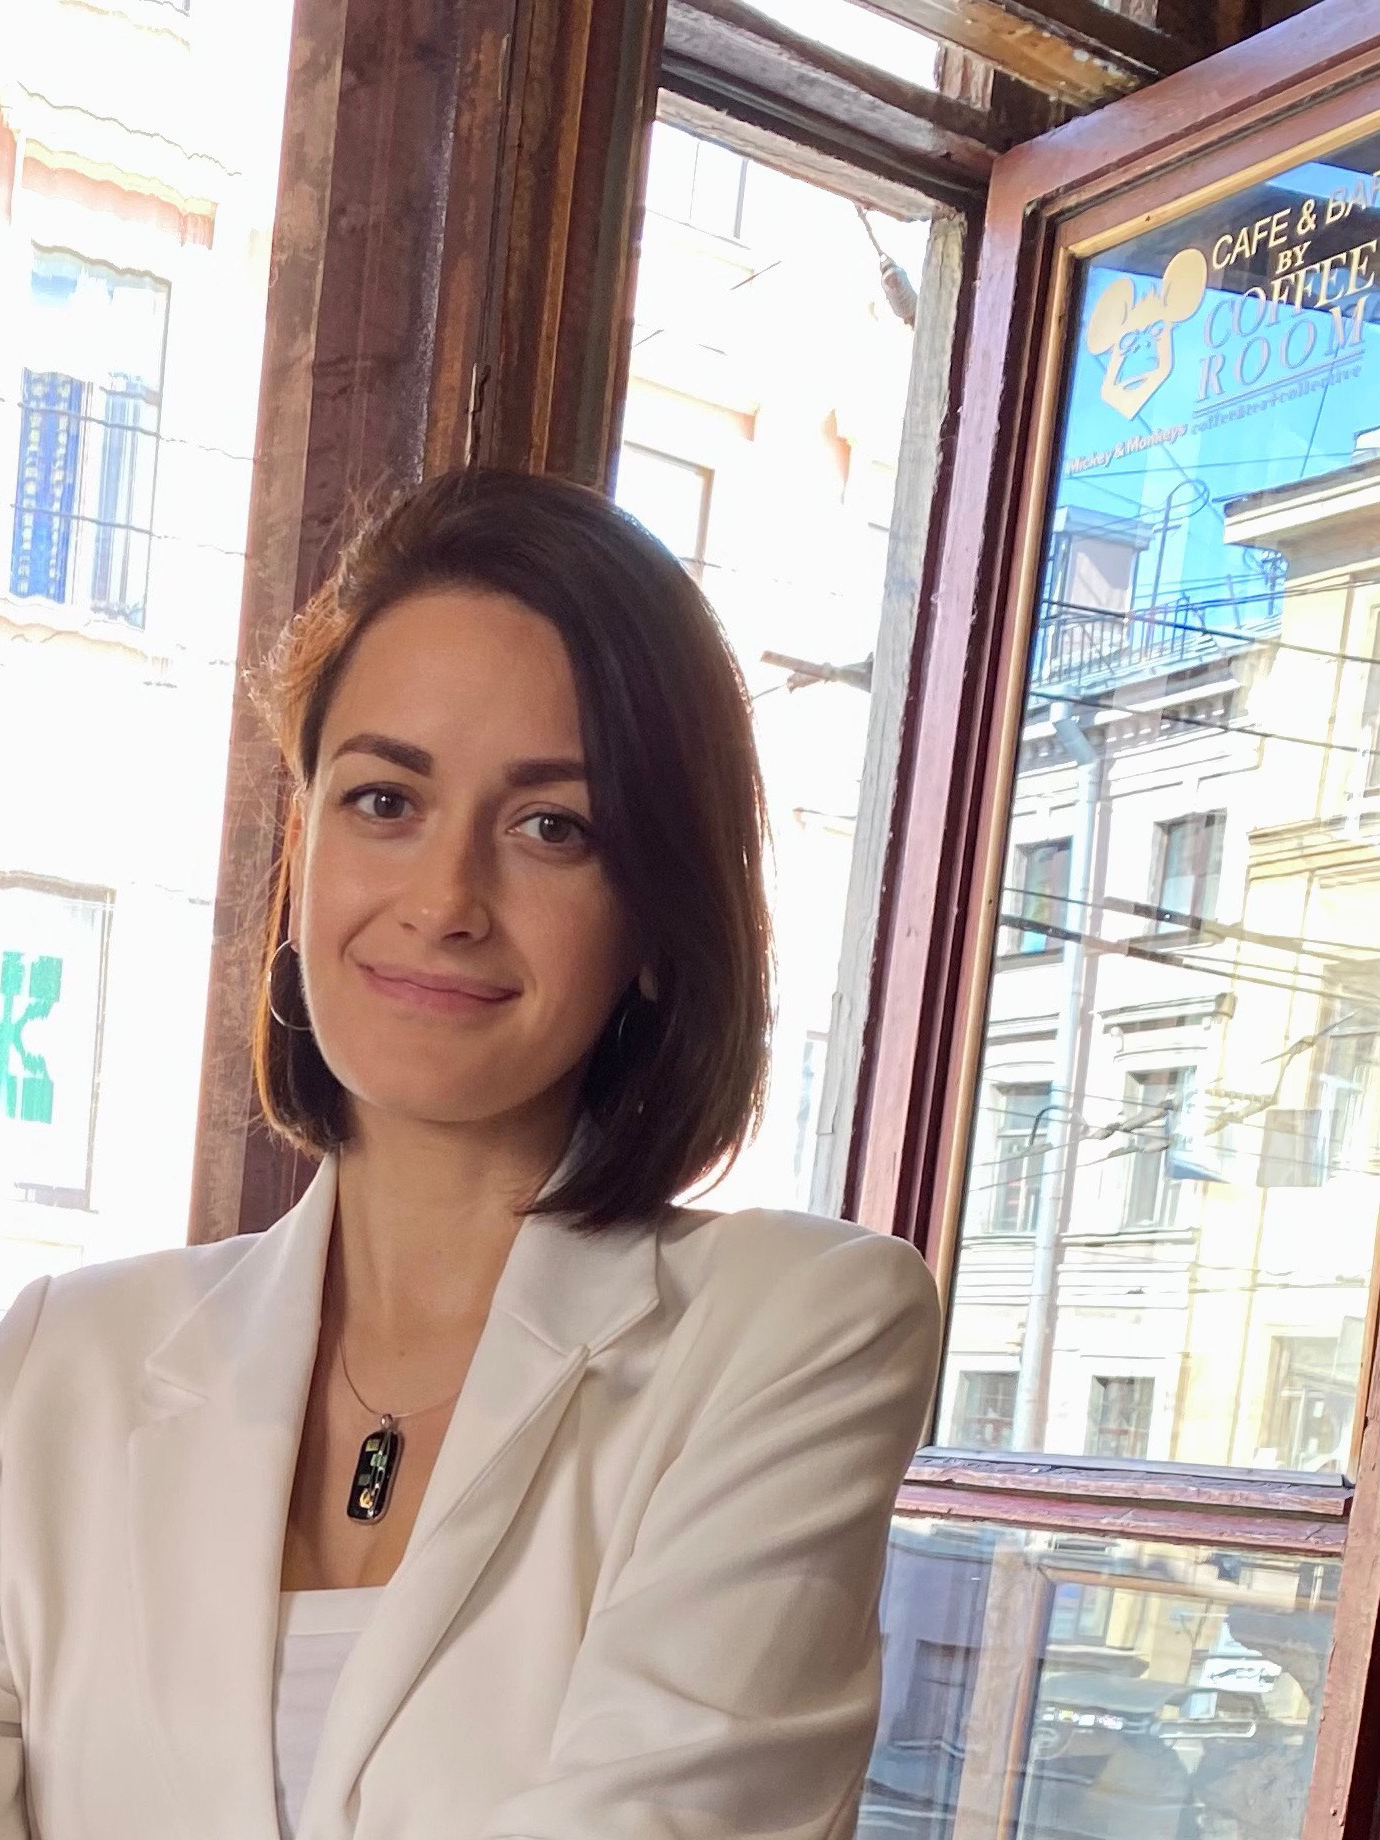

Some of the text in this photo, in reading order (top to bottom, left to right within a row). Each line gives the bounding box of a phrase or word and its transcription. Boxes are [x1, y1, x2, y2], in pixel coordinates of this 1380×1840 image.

[1212, 207, 1292, 270] CAFE
[1296, 199, 1318, 236] &
[1275, 241, 1312, 275] BY
[1203, 239, 1377, 349] COFFEE
[1196, 294, 1367, 403] ROOM
